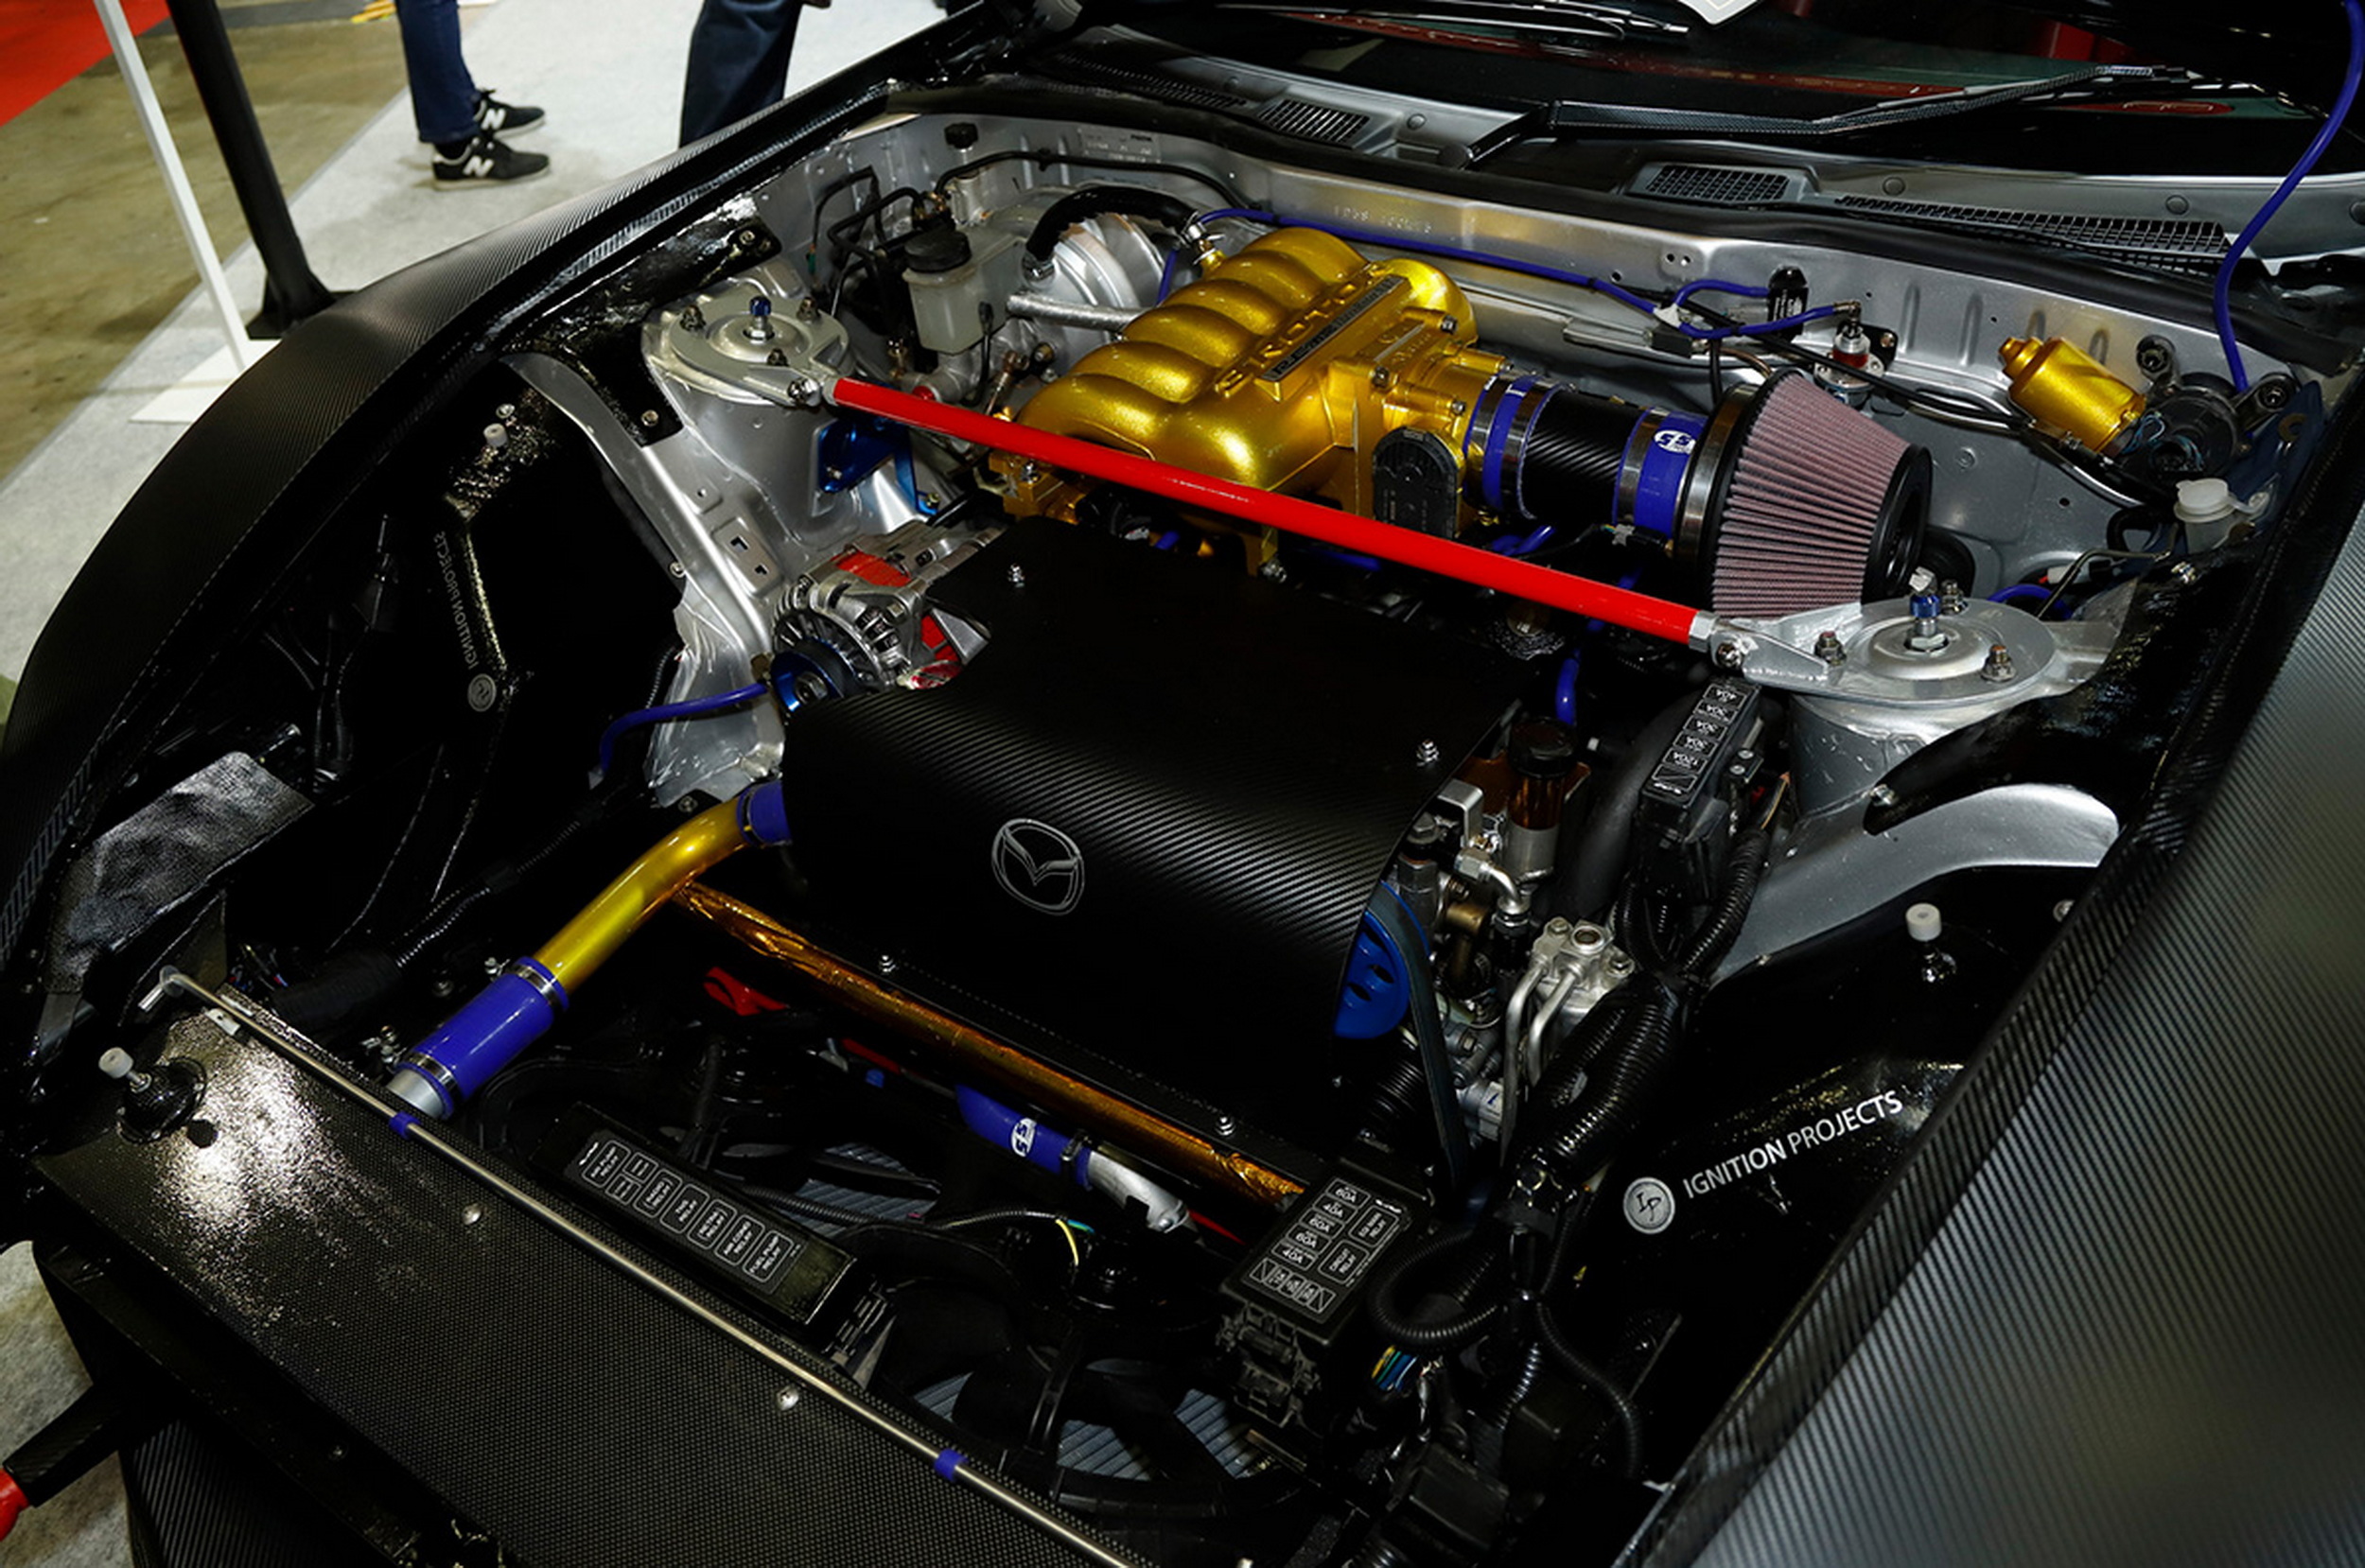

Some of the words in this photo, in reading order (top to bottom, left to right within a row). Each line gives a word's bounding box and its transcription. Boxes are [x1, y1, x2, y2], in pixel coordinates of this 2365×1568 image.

[481, 108, 506, 131] N
[462, 155, 494, 177] N
[1683, 1138, 1788, 1199] IGNITION
[1787, 1089, 1903, 1156] PROJECTS
